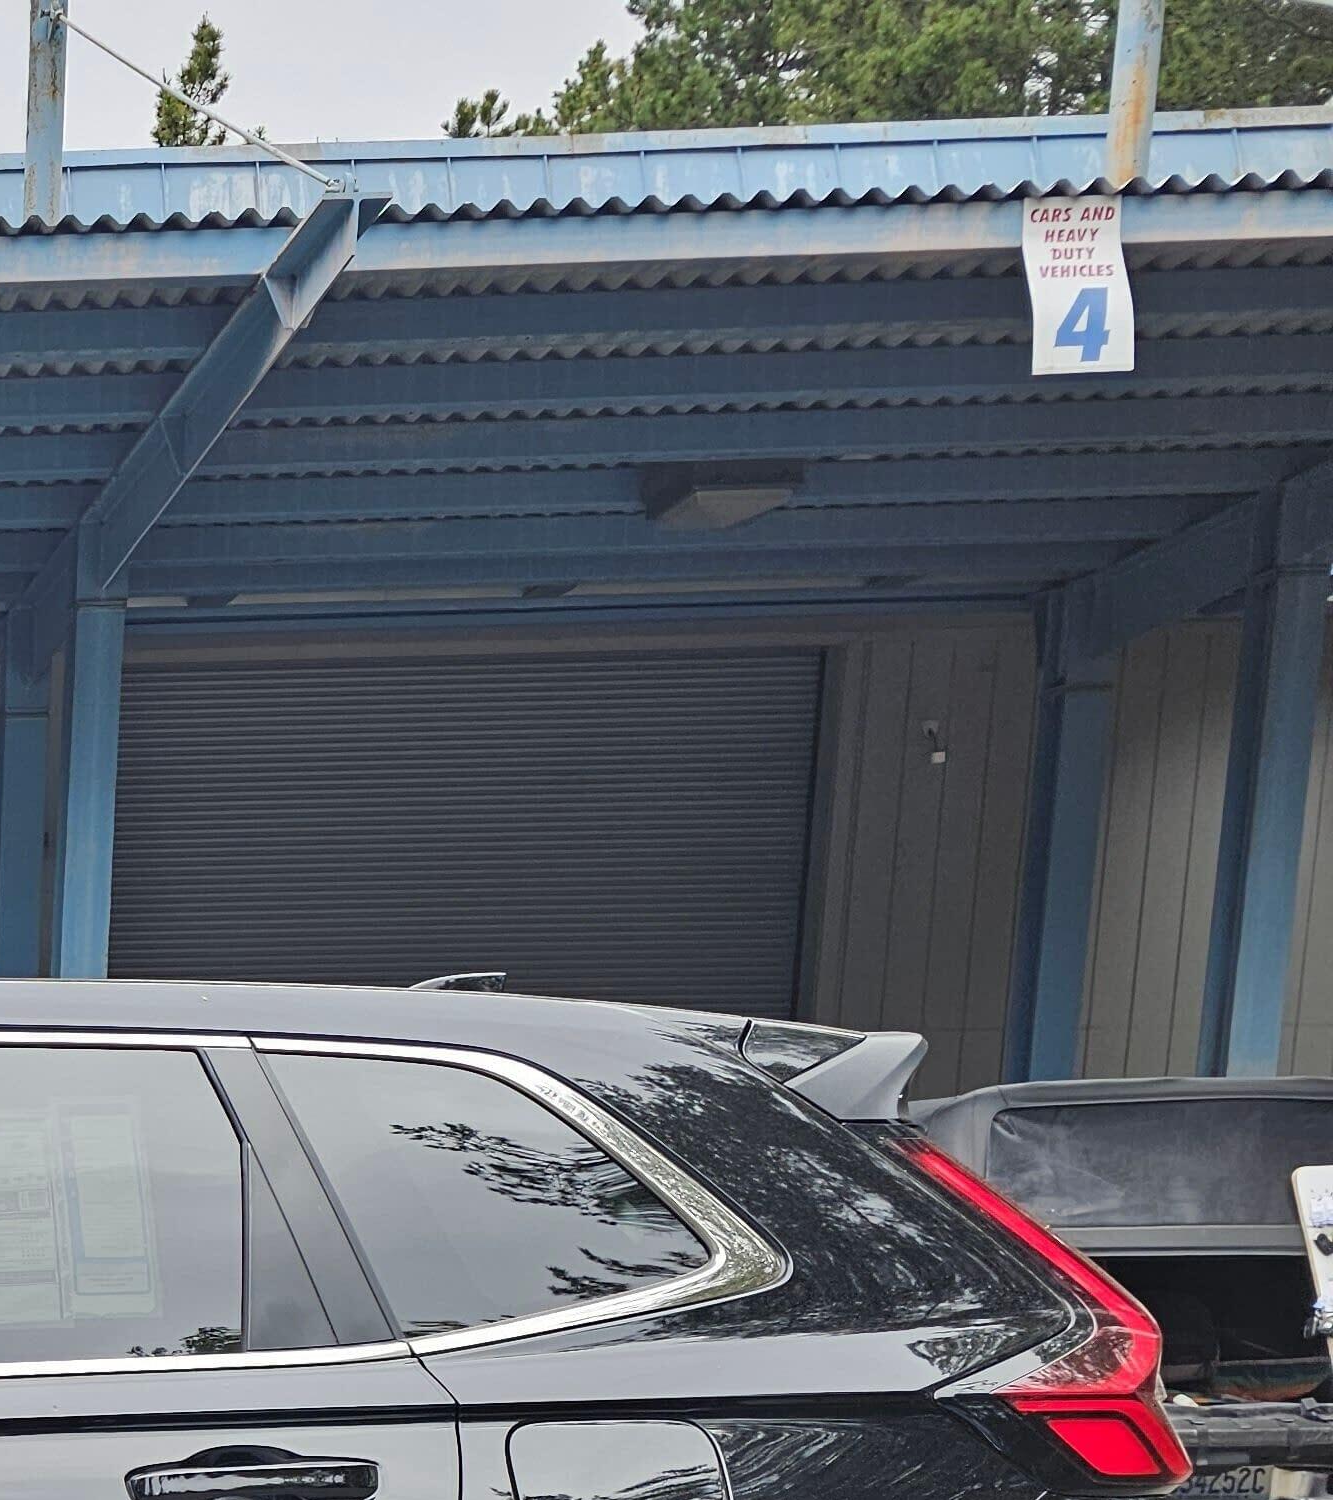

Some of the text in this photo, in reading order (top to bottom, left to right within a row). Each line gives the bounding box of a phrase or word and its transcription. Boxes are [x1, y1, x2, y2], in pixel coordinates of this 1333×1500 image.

[1031, 206, 1115, 223] CARS AND
[1044, 228, 1100, 243] HEAVY
[1050, 247, 1096, 261] DUTY
[1039, 264, 1115, 278] VEHICLES
[1053, 287, 1110, 363] 4
